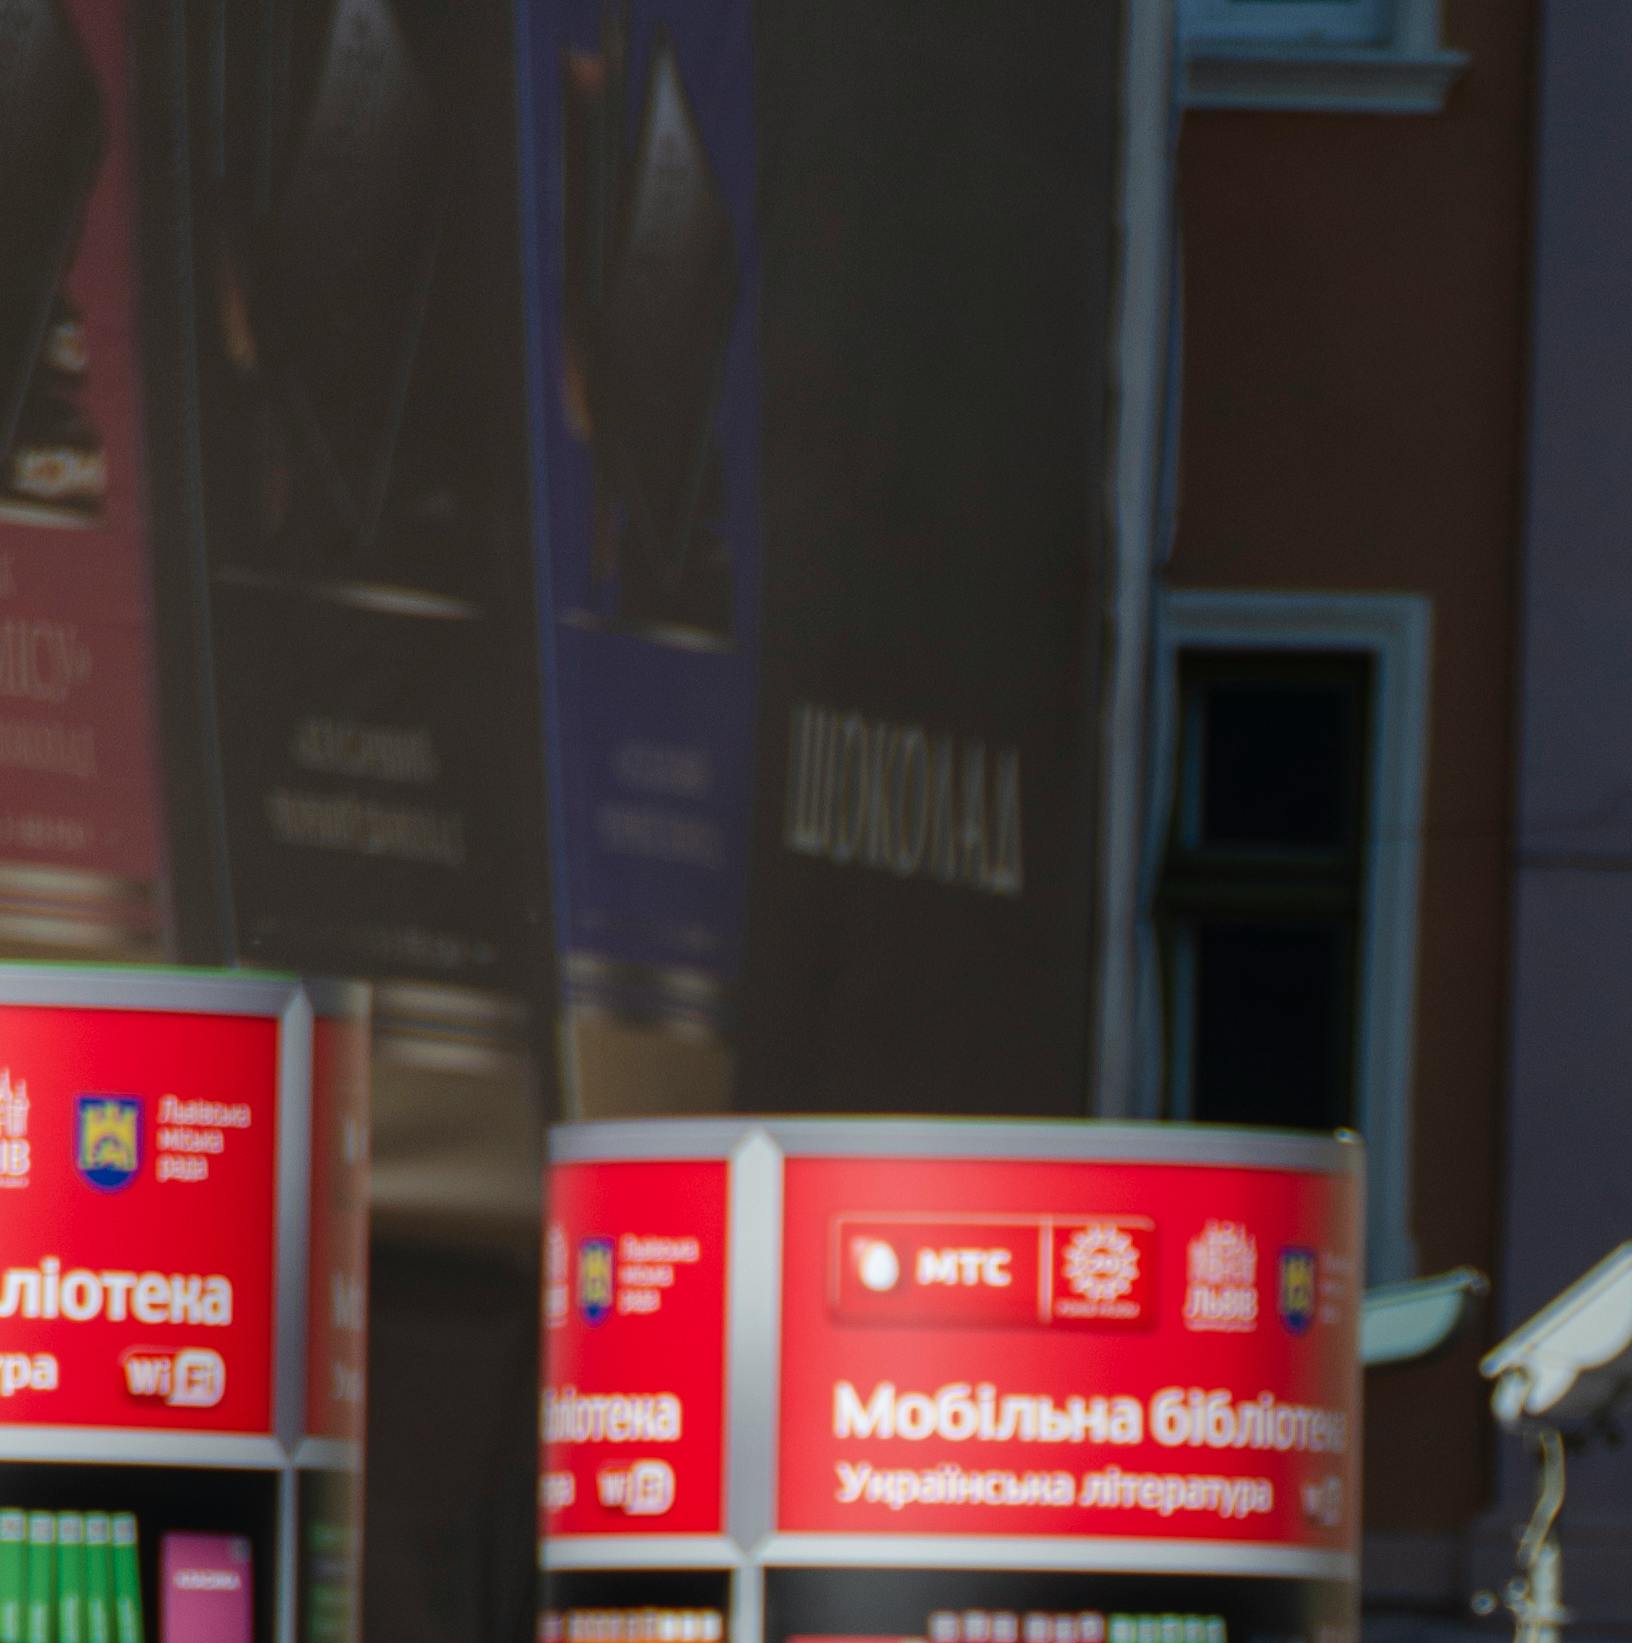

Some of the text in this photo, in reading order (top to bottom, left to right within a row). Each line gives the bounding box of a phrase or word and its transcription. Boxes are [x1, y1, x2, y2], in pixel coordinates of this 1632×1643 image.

[785, 702, 1023, 896] ШОКОЛАД
[917, 1248, 1011, 1287] МТС
[0, 1353, 59, 1396] ра
[834, 1381, 1142, 1445] Мобільна
[836, 1462, 1074, 1511] Українська
[1079, 1464, 1273, 1519] література
